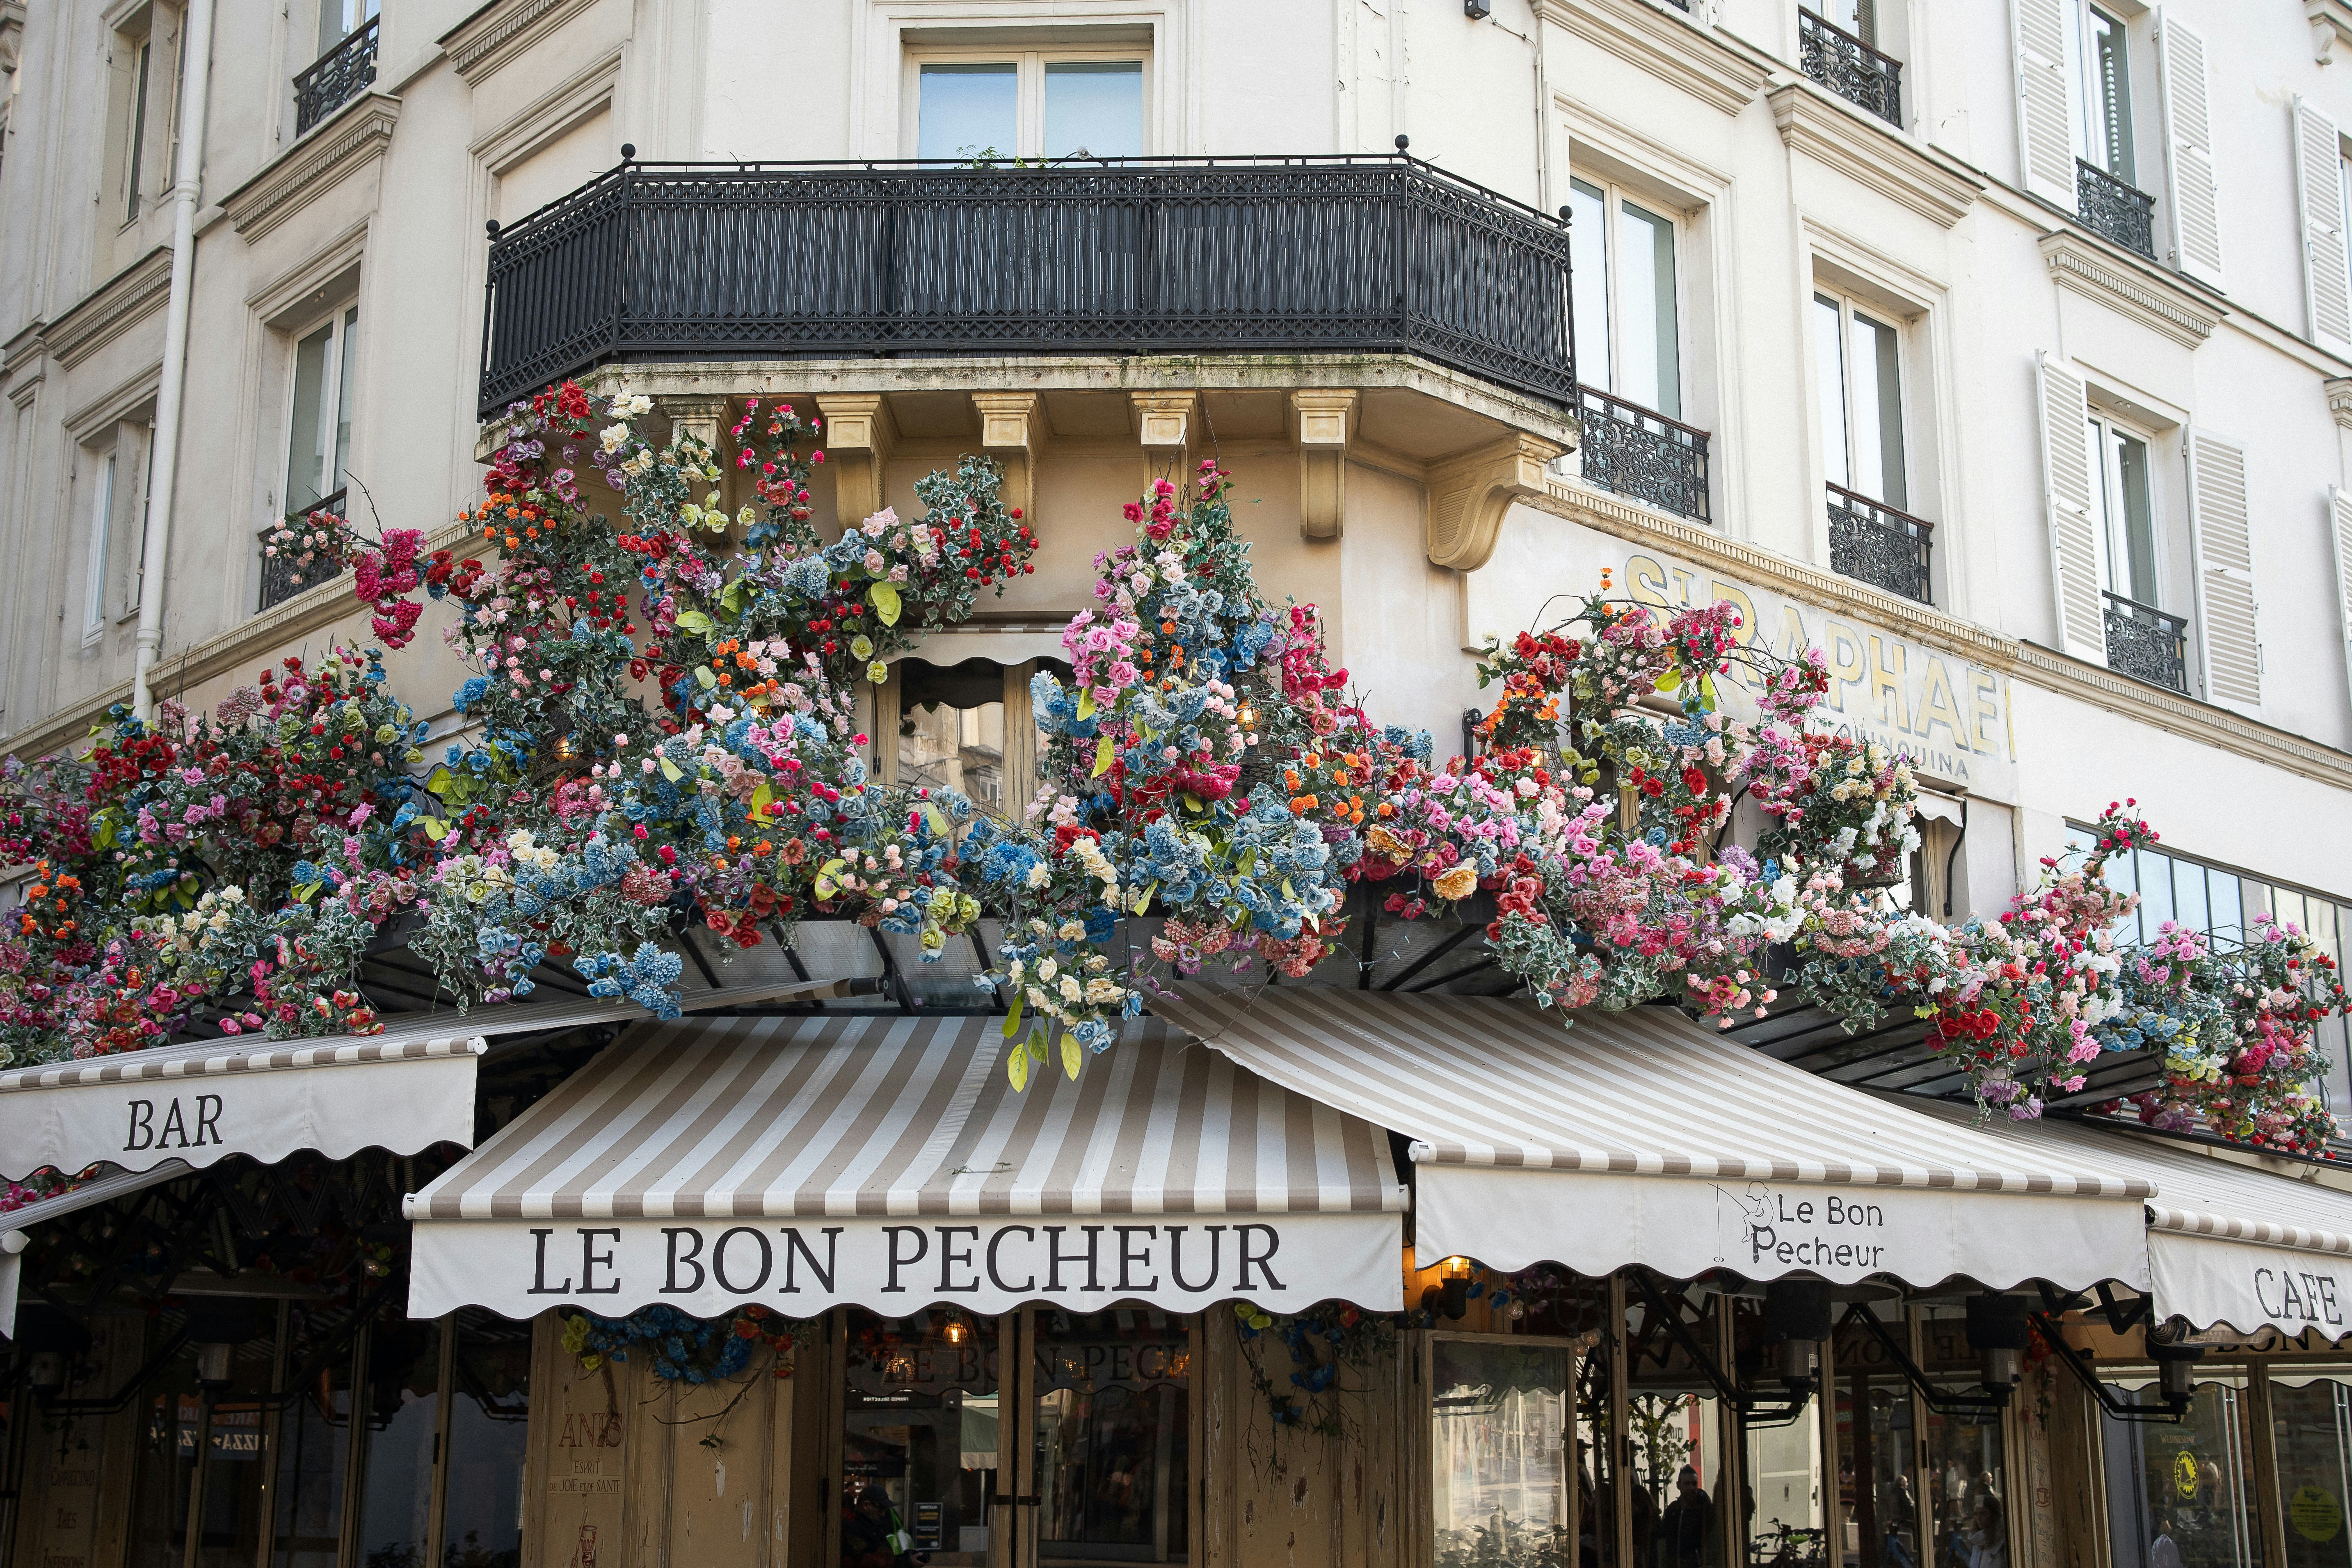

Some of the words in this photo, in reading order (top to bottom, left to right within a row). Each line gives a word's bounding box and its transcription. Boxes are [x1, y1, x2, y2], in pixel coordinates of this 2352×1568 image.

[123, 1094, 223, 1151] BAR
[1778, 1193, 1814, 1224] Le
[1828, 1196, 1883, 1226] Bon
[527, 1228, 620, 1294] LE
[659, 1227, 843, 1294] BON
[881, 1224, 1287, 1293] PECHEUR
[1753, 1225, 1884, 1268] Pecheur
[2255, 1268, 2342, 1325] CAFE
[558, 1413, 623, 1447] ANIS
[549, 1483, 557, 1491] DE
[559, 1479, 578, 1492] JOIE
[579, 1483, 586, 1492] ET
[587, 1483, 594, 1492] DE
[597, 1477, 620, 1492] SANTÉ
[574, 1461, 600, 1474] ESPRIT
